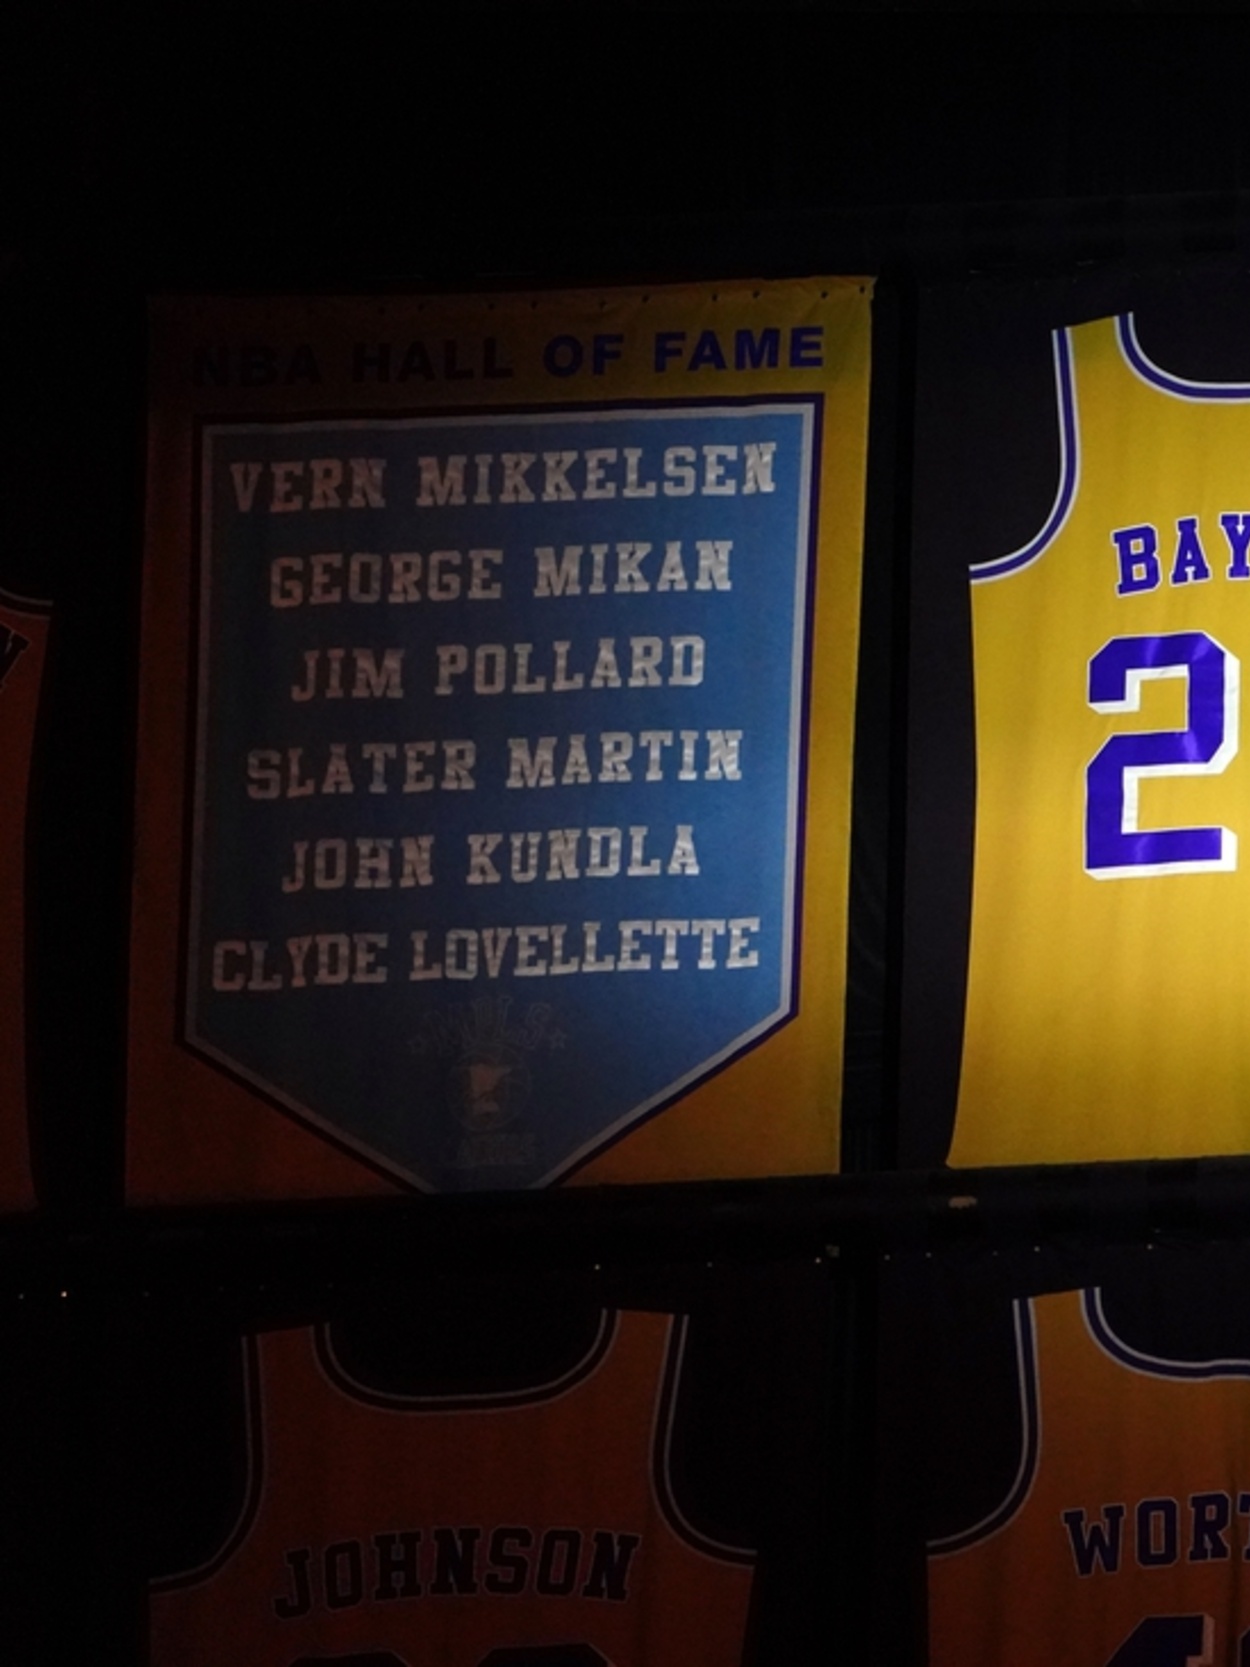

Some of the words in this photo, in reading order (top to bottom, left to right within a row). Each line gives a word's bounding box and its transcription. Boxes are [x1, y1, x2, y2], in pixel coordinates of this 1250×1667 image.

[192, 343, 323, 389] NBA
[351, 338, 514, 383] HALL
[543, 334, 625, 378] OF
[654, 326, 824, 374] FAME
[230, 457, 388, 513] VERN
[415, 442, 777, 508] MIKKELSEN
[269, 549, 504, 609] GEORGE
[533, 540, 734, 599] MIKAN
[290, 647, 405, 702] JIM
[434, 634, 705, 698] POLLARD
[246, 738, 477, 800] SLATER
[506, 729, 743, 788] MARTIN
[281, 834, 435, 893] JOHN
[466, 825, 700, 886] KUNDLA
[211, 932, 388, 993] CLYDE
[408, 917, 760, 981] LOVELLETTE
[273, 1525, 640, 1619] JOHNSON
